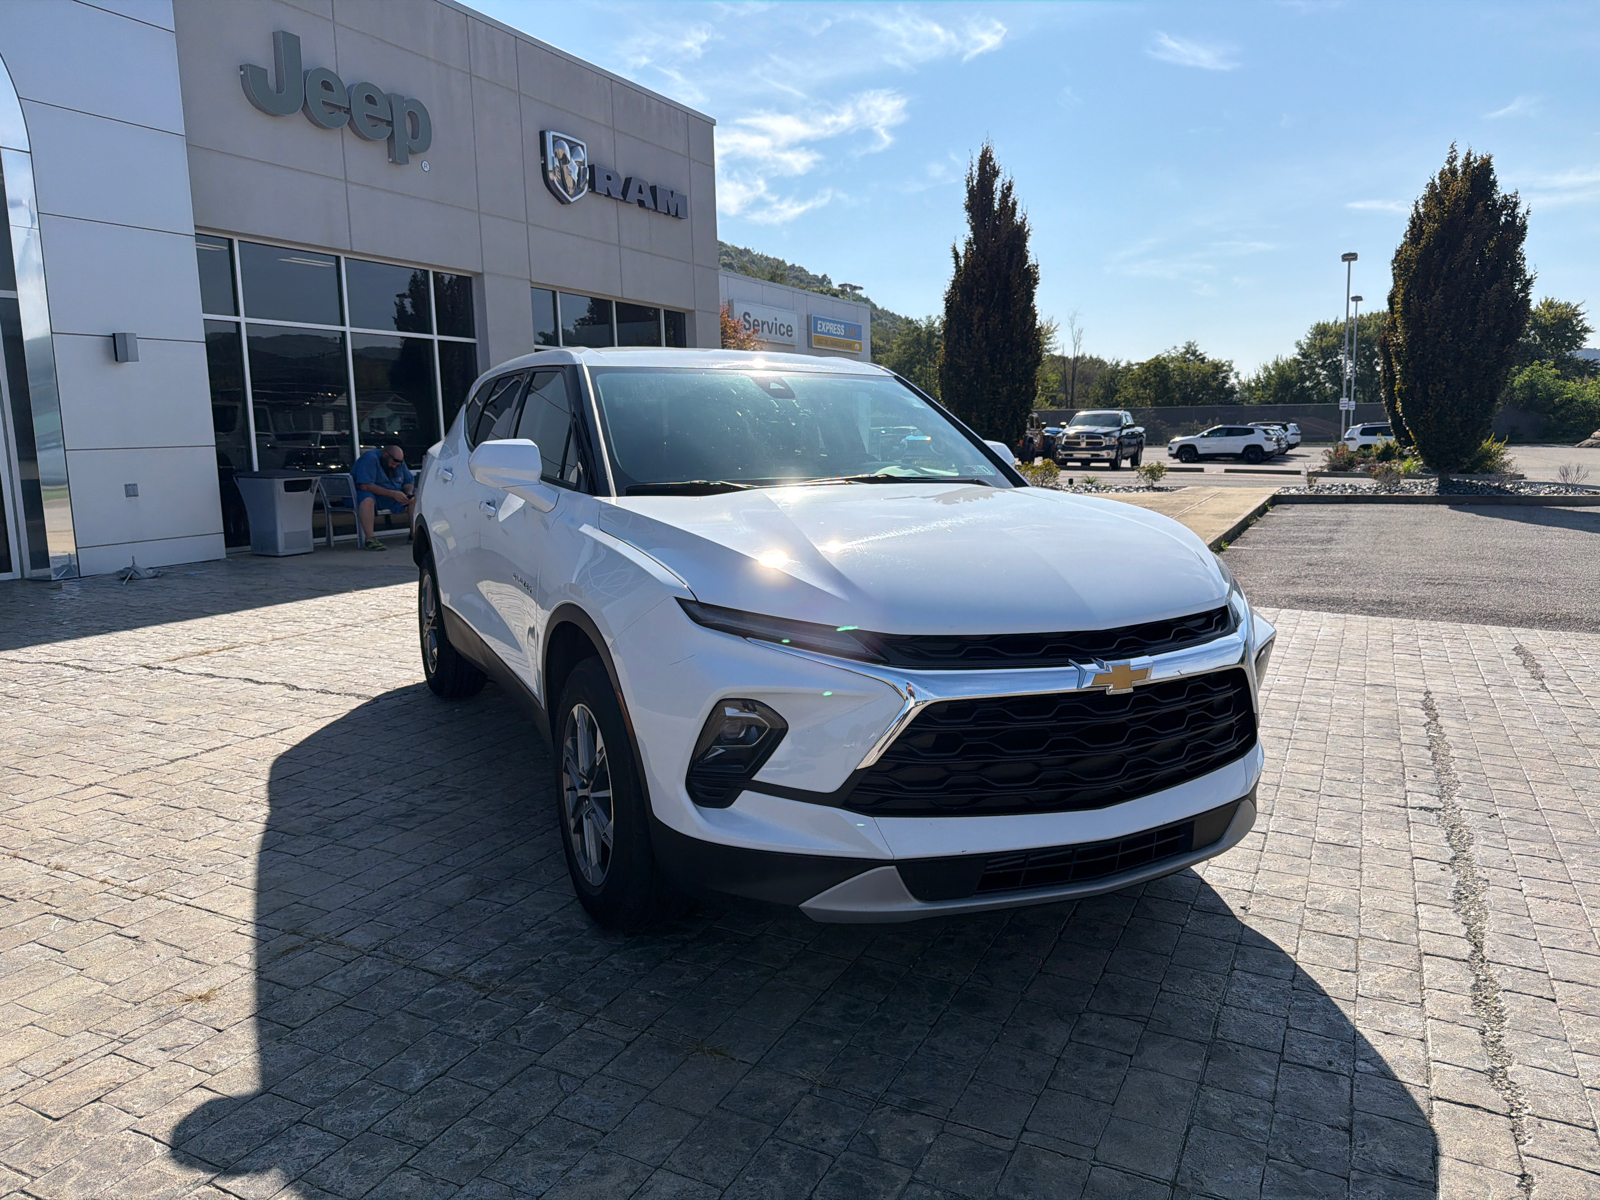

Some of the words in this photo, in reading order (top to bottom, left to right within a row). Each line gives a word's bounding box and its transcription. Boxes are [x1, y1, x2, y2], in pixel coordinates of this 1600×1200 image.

[240, 30, 432, 165] Jeep
[588, 164, 688, 219] RAM
[743, 311, 793, 337] Service
[817, 320, 845, 336] EXPRESS
